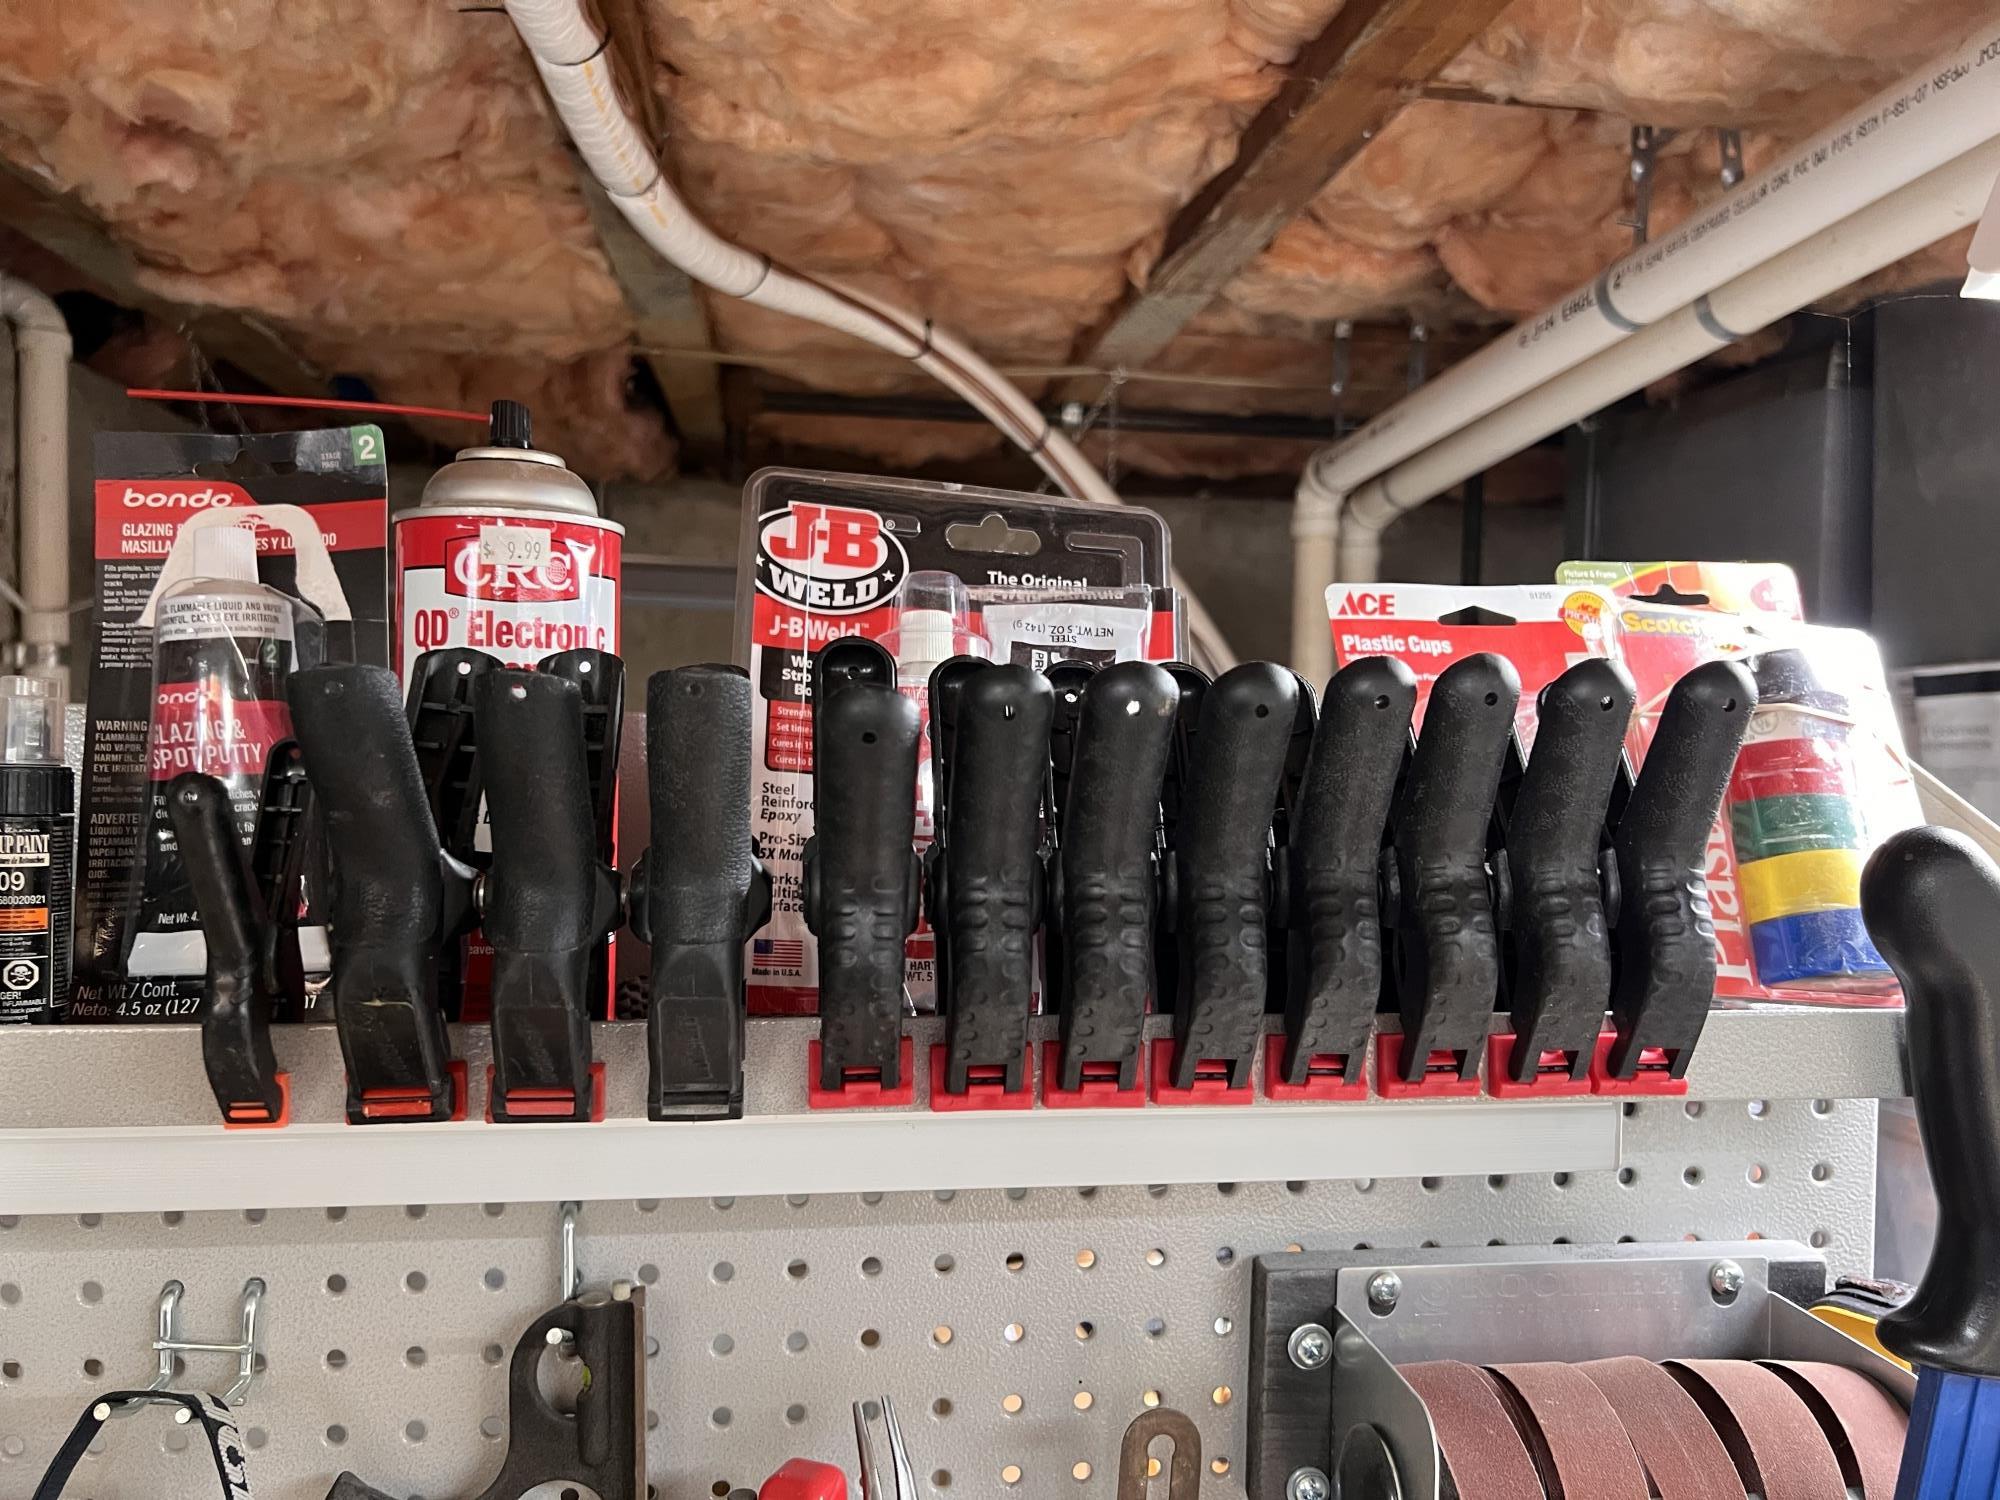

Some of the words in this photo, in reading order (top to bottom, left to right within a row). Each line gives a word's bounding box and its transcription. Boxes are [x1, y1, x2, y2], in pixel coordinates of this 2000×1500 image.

[358, 435, 377, 459] 2
[123, 487, 232, 508] bondo
[122, 523, 174, 537] GLAZING
[121, 540, 173, 553] MASILLA
[271, 537, 279, 550] Y
[507, 541, 542, 560] 9.99
[454, 545, 572, 592] CRC
[768, 563, 879, 608] WELD
[987, 570, 1019, 585] The
[1021, 573, 1088, 590] Original
[214, 600, 243, 611] LIQUID
[1337, 590, 1395, 616] ACE
[223, 613, 239, 622] EYE
[467, 608, 606, 652] Electronc
[1025, 621, 1047, 635] (142
[1067, 625, 1074, 635] 5
[1094, 627, 1114, 637] NET
[1051, 634, 1077, 643] STEEL
[1341, 634, 1406, 653] Plastic
[1407, 635, 1453, 657] Cups
[267, 643, 277, 664] 2
[96, 720, 148, 731] WARNING
[776, 722, 790, 732] Set
[790, 723, 810, 734] time
[94, 743, 112, 751] AND
[771, 738, 794, 749] Cures
[153, 747, 200, 769] SPOT
[207, 743, 262, 765] PUTTY
[774, 754, 797, 766] Cures
[93, 764, 110, 772] EYE
[112, 764, 147, 773] IRRITATI
[762, 782, 795, 796] Steel
[761, 795, 816, 810] Reinforc
[90, 813, 140, 825] ADVERTE
[760, 808, 802, 824] Epoxy
[16, 834, 50, 853] PAINT
[759, 832, 807, 847] Pro-Siz
[778, 849, 804, 861] Mor
[771, 873, 799, 886] orks
[0, 991, 22, 1000] GER!
[77, 986, 101, 1000] Net
[141, 981, 180, 998] Cont.
[72, 1002, 112, 1017] Neto:
[116, 1002, 142, 1016] 4.5
[144, 1003, 162, 1016] oz
